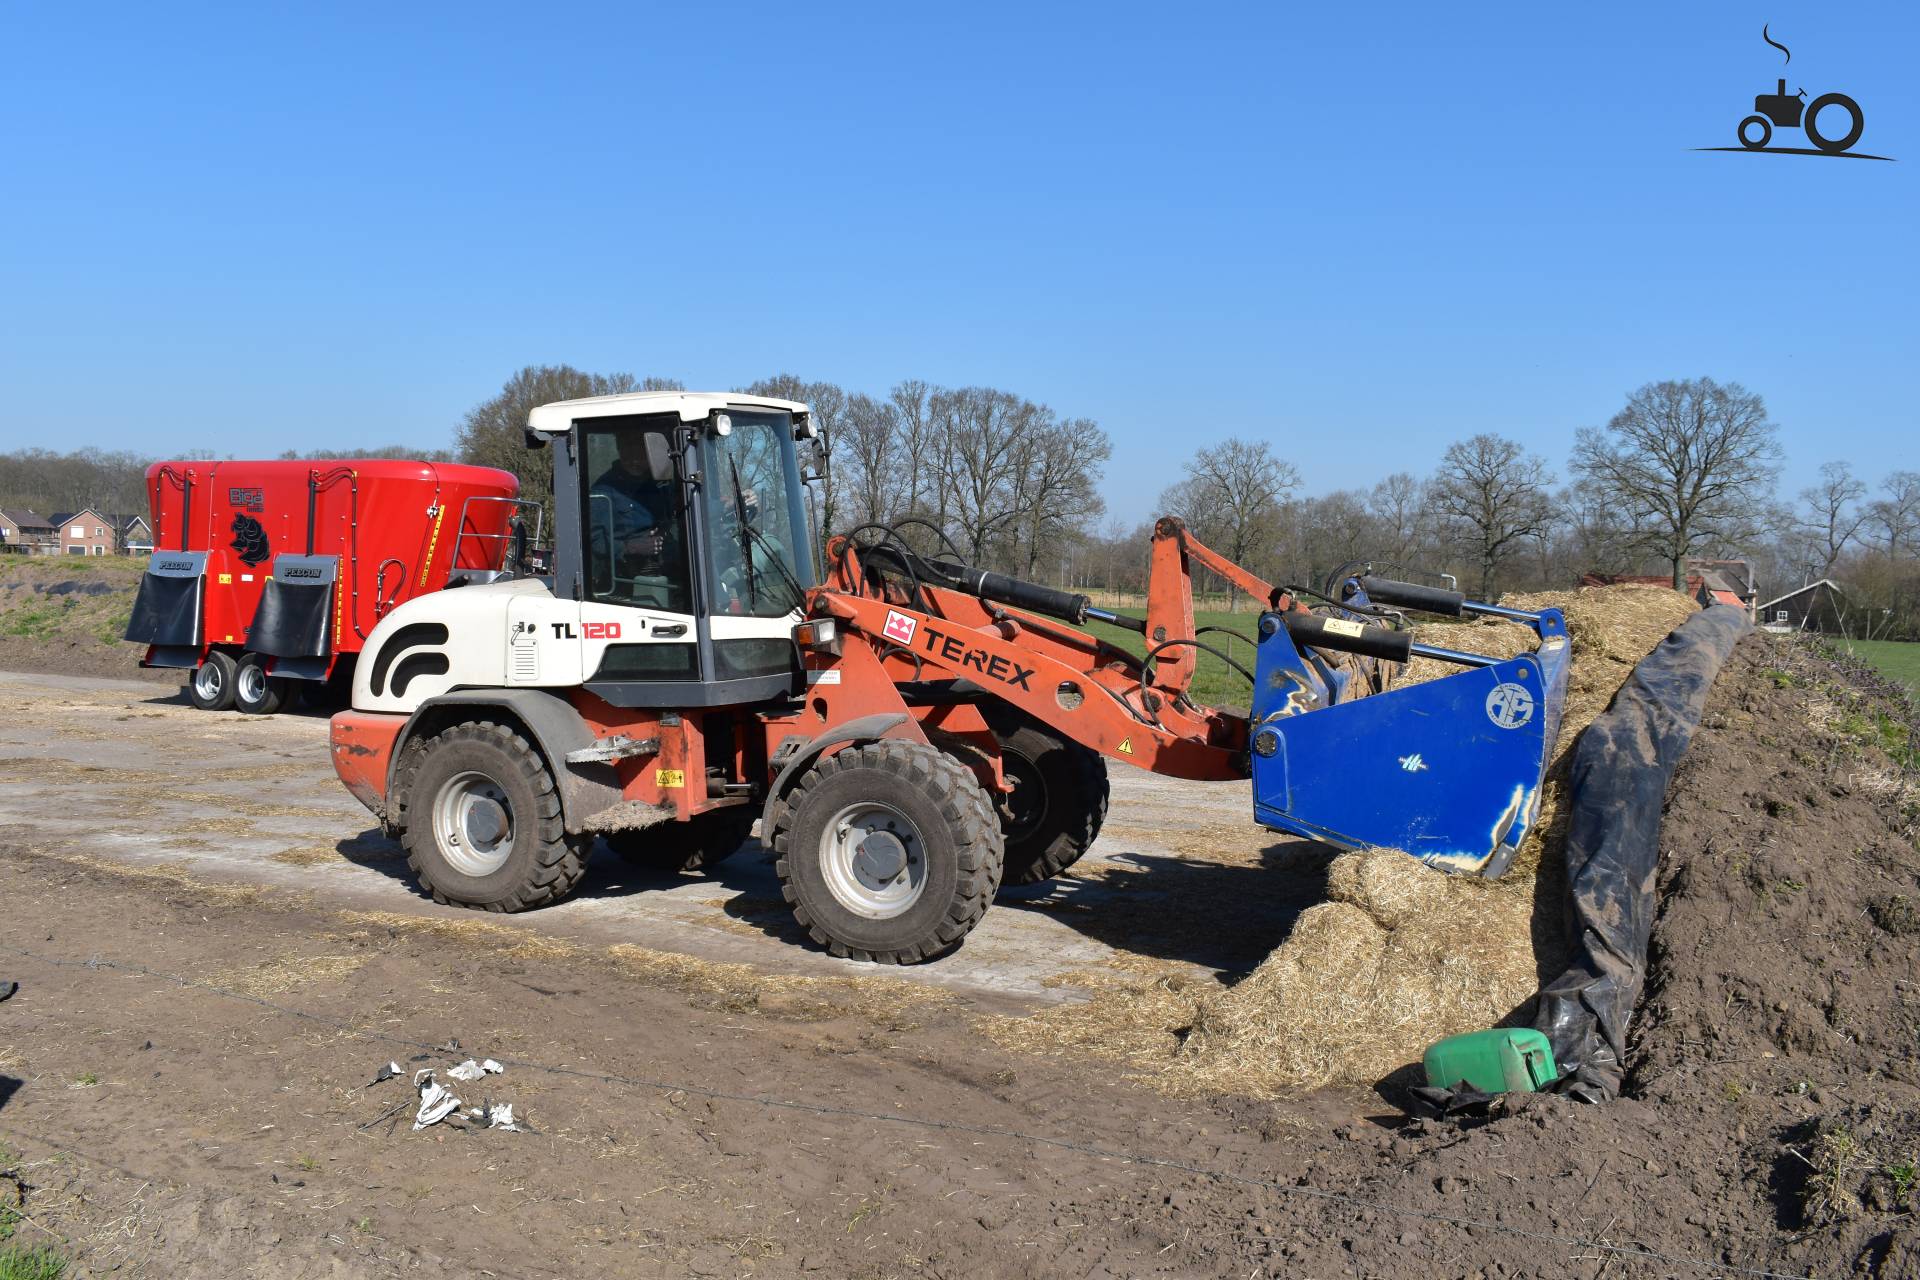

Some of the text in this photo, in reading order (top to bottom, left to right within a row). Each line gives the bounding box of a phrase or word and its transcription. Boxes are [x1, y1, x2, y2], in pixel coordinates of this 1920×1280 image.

[284, 567, 322, 578] PEECON
[551, 622, 621, 639] TL 120
[923, 627, 1035, 692] TEREX
